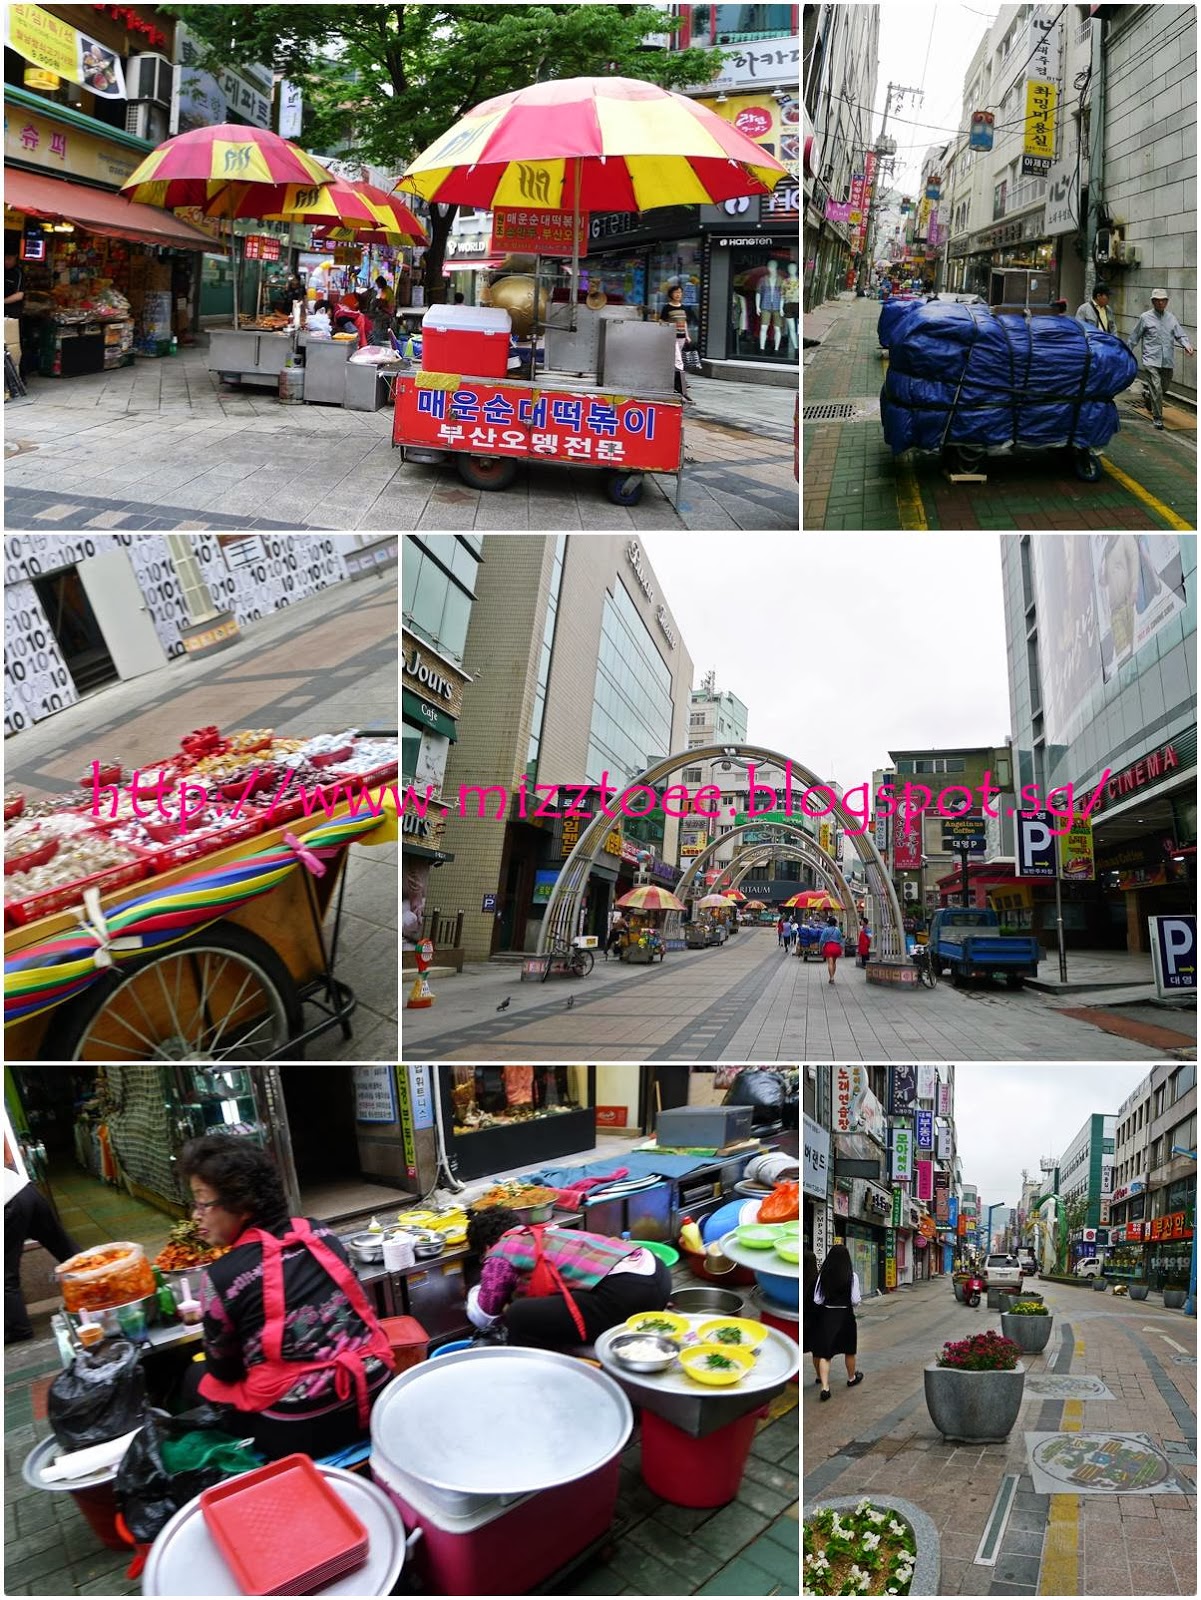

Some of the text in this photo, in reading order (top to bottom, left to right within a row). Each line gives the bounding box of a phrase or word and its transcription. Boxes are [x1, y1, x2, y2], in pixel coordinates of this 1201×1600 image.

[458, 240, 485, 253] WORLD
[417, 389, 655, 440] 매운순대떡볶이
[436, 423, 627, 462] 부산오뎅전문
[404, 649, 454, 701] Jours
[421, 703, 438, 721] Cafe
[1107, 744, 1179, 800] CINEMA
[1022, 821, 1052, 867] P
[1163, 919, 1193, 975] P
